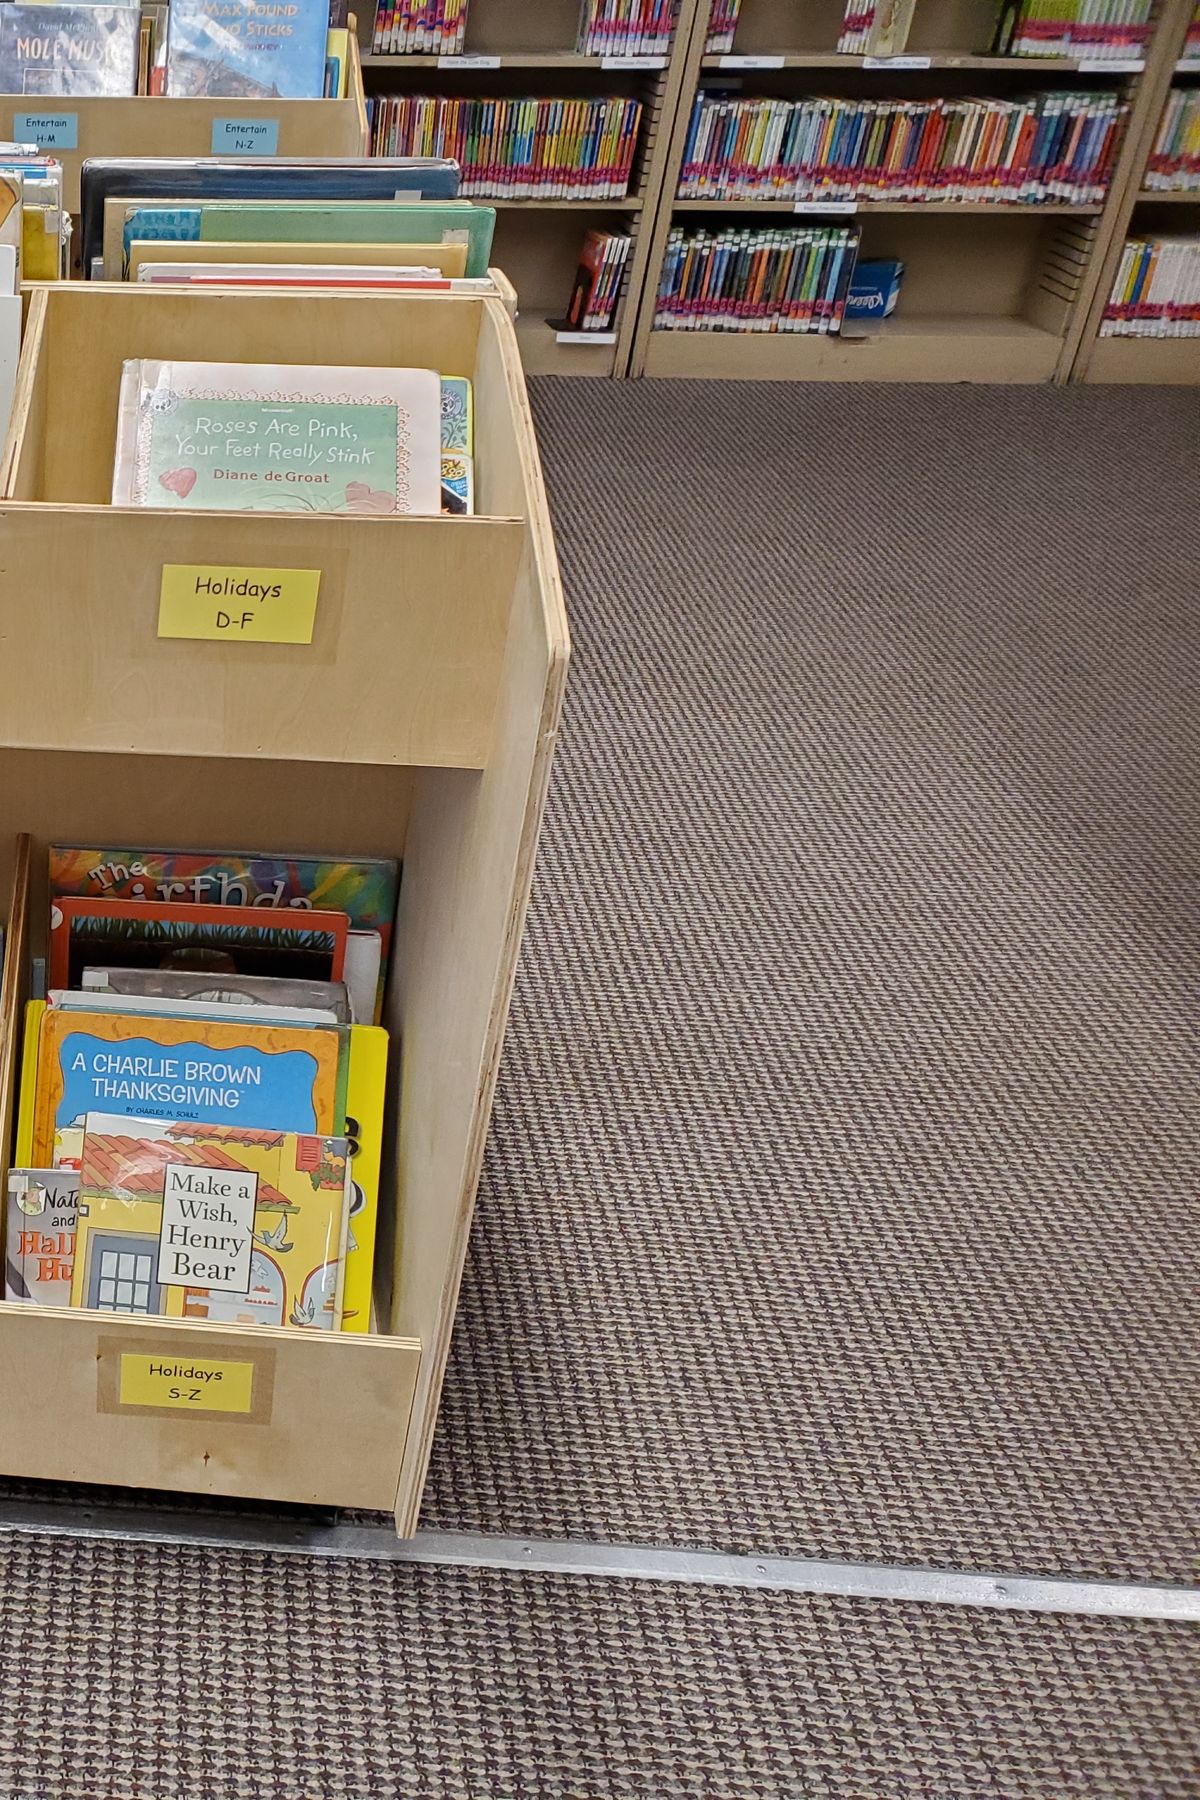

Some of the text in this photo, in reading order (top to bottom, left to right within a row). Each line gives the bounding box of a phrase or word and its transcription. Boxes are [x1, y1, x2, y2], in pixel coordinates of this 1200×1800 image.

[248, 4, 299, 17] FOUND
[246, 20, 294, 37] STICKS
[17, 37, 62, 60] MOLE
[26, 118, 67, 128] Entertain
[225, 123, 267, 134] Entertain
[36, 134, 56, 143] H-M
[235, 140, 255, 149] N-Z
[195, 417, 358, 441] Roses Are Pink,
[176, 434, 376, 467] Your Feet Really Stink
[213, 469, 258, 481] Diane
[195, 576, 282, 603] Holidays
[216, 611, 255, 630] D-F
[89, 860, 146, 890] The
[71, 1053, 262, 1086] A CHARLIE BROWN
[91, 1078, 241, 1109] THANKSGIVING
[169, 1172, 251, 1199] Make a
[52, 1214, 76, 1227] and
[177, 1198, 238, 1226] Wish,
[166, 1224, 247, 1258] Henry
[171, 1251, 237, 1281] Bear
[150, 1363, 224, 1383] Holidays
[167, 1387, 202, 1401] S-Z
